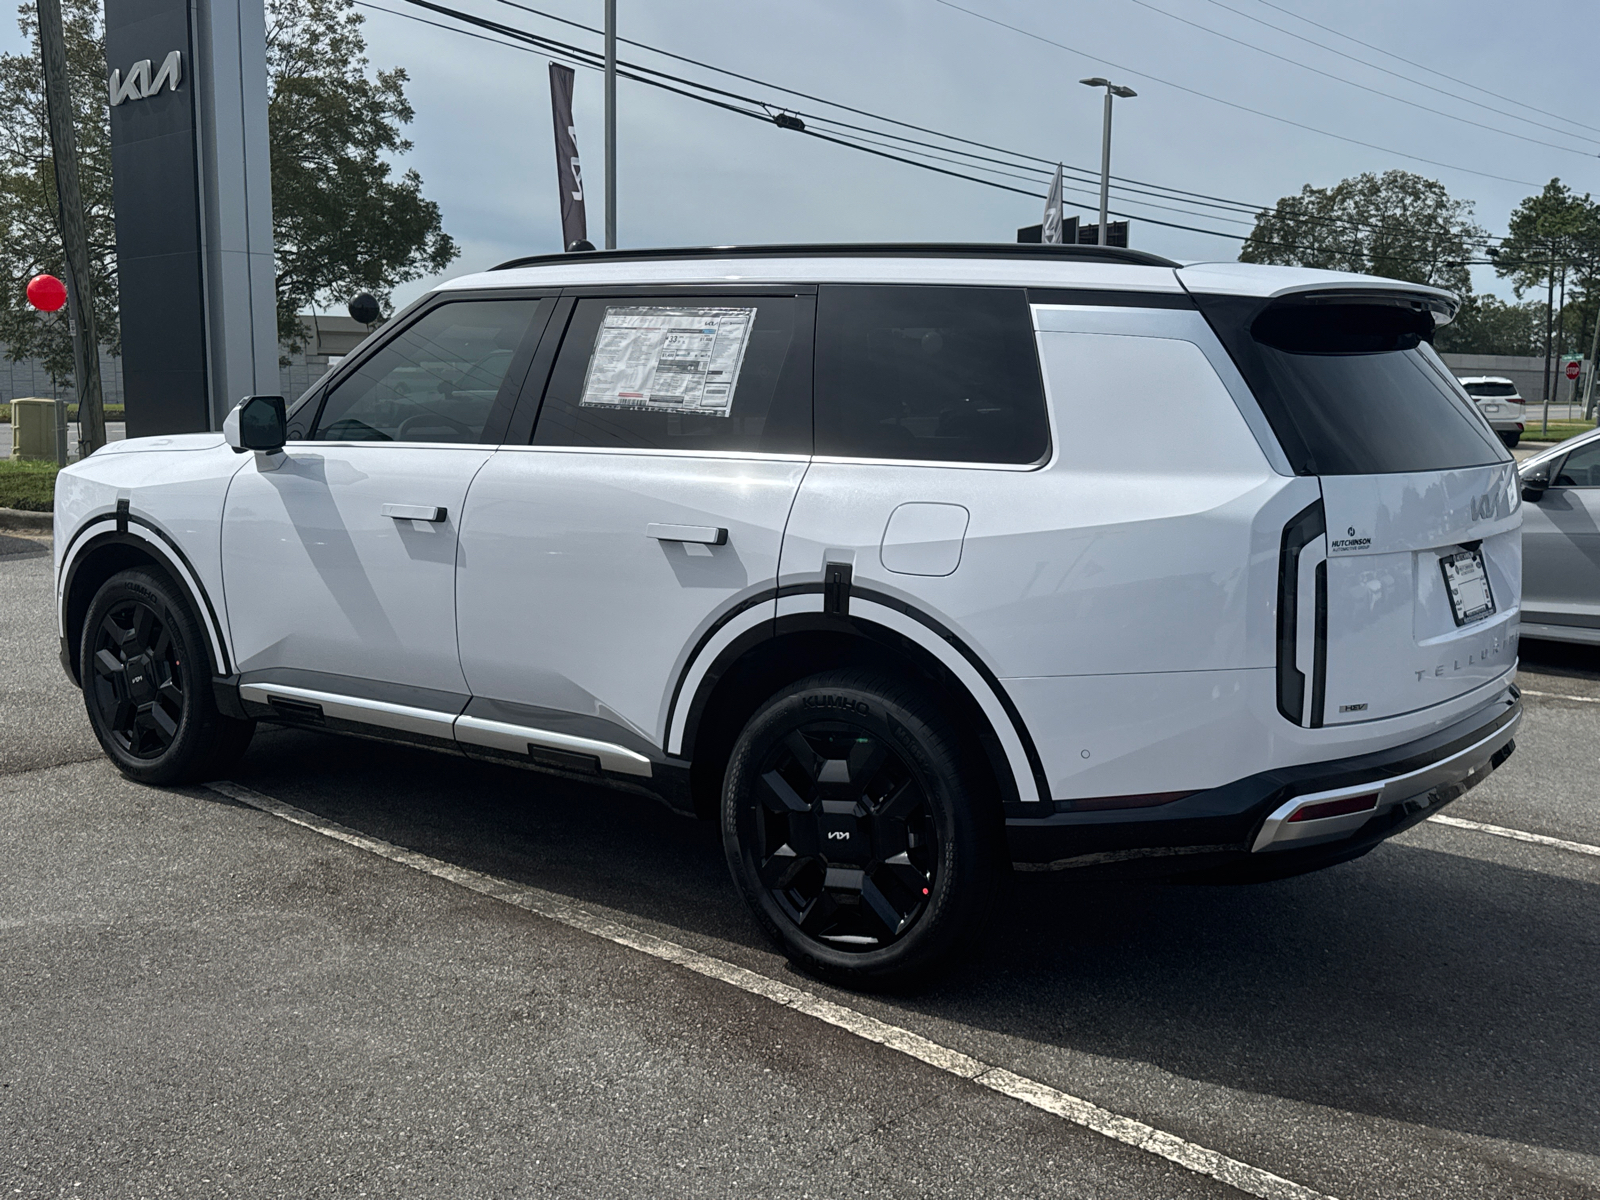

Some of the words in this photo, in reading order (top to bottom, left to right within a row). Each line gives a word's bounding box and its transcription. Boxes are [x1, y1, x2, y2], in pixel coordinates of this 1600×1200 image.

[109, 50, 181, 106] KIA
[1566, 367, 1580, 375] STOP
[1331, 538, 1371, 548] HUTCHINSON
[124, 581, 158, 605] KUMHO
[802, 694, 870, 717] KUMHO
[1344, 703, 1366, 711] HEV
[828, 831, 850, 840] KIA
